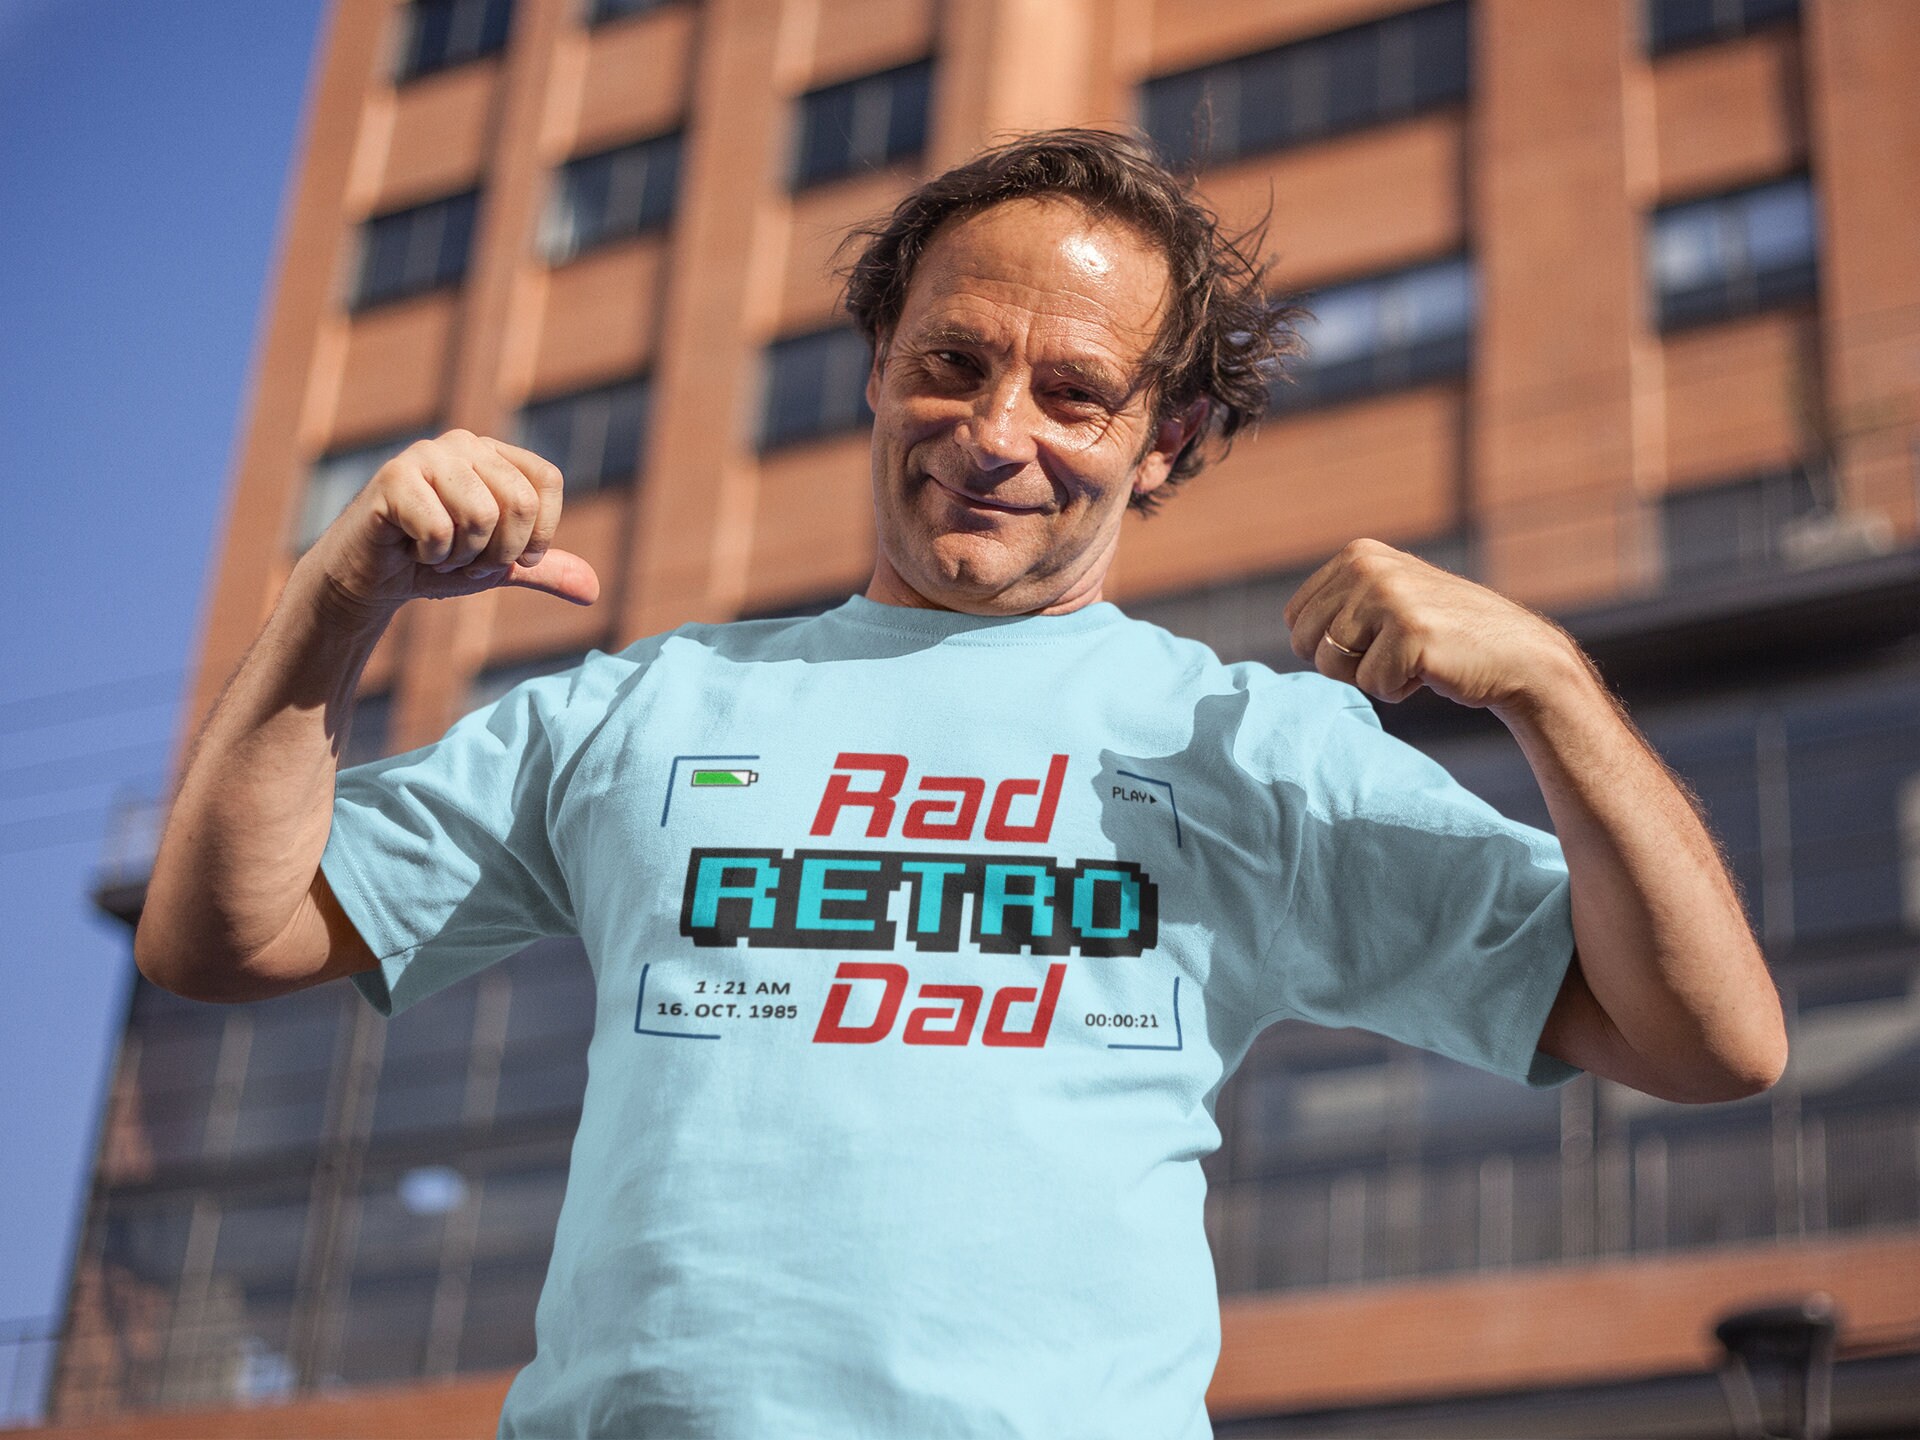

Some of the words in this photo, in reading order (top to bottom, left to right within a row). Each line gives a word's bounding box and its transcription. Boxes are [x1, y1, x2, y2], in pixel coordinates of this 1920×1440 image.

[809, 752, 1069, 843] Rad
[1112, 786, 1148, 803] PLAY
[690, 857, 1141, 939] RETRO
[755, 982, 791, 995] AM
[657, 1003, 688, 1016] 16.
[694, 1004, 741, 1018] OCT.
[748, 1005, 798, 1019] 1985
[812, 962, 1067, 1048] Dad
[1085, 1013, 1159, 1028] 00:00:21
